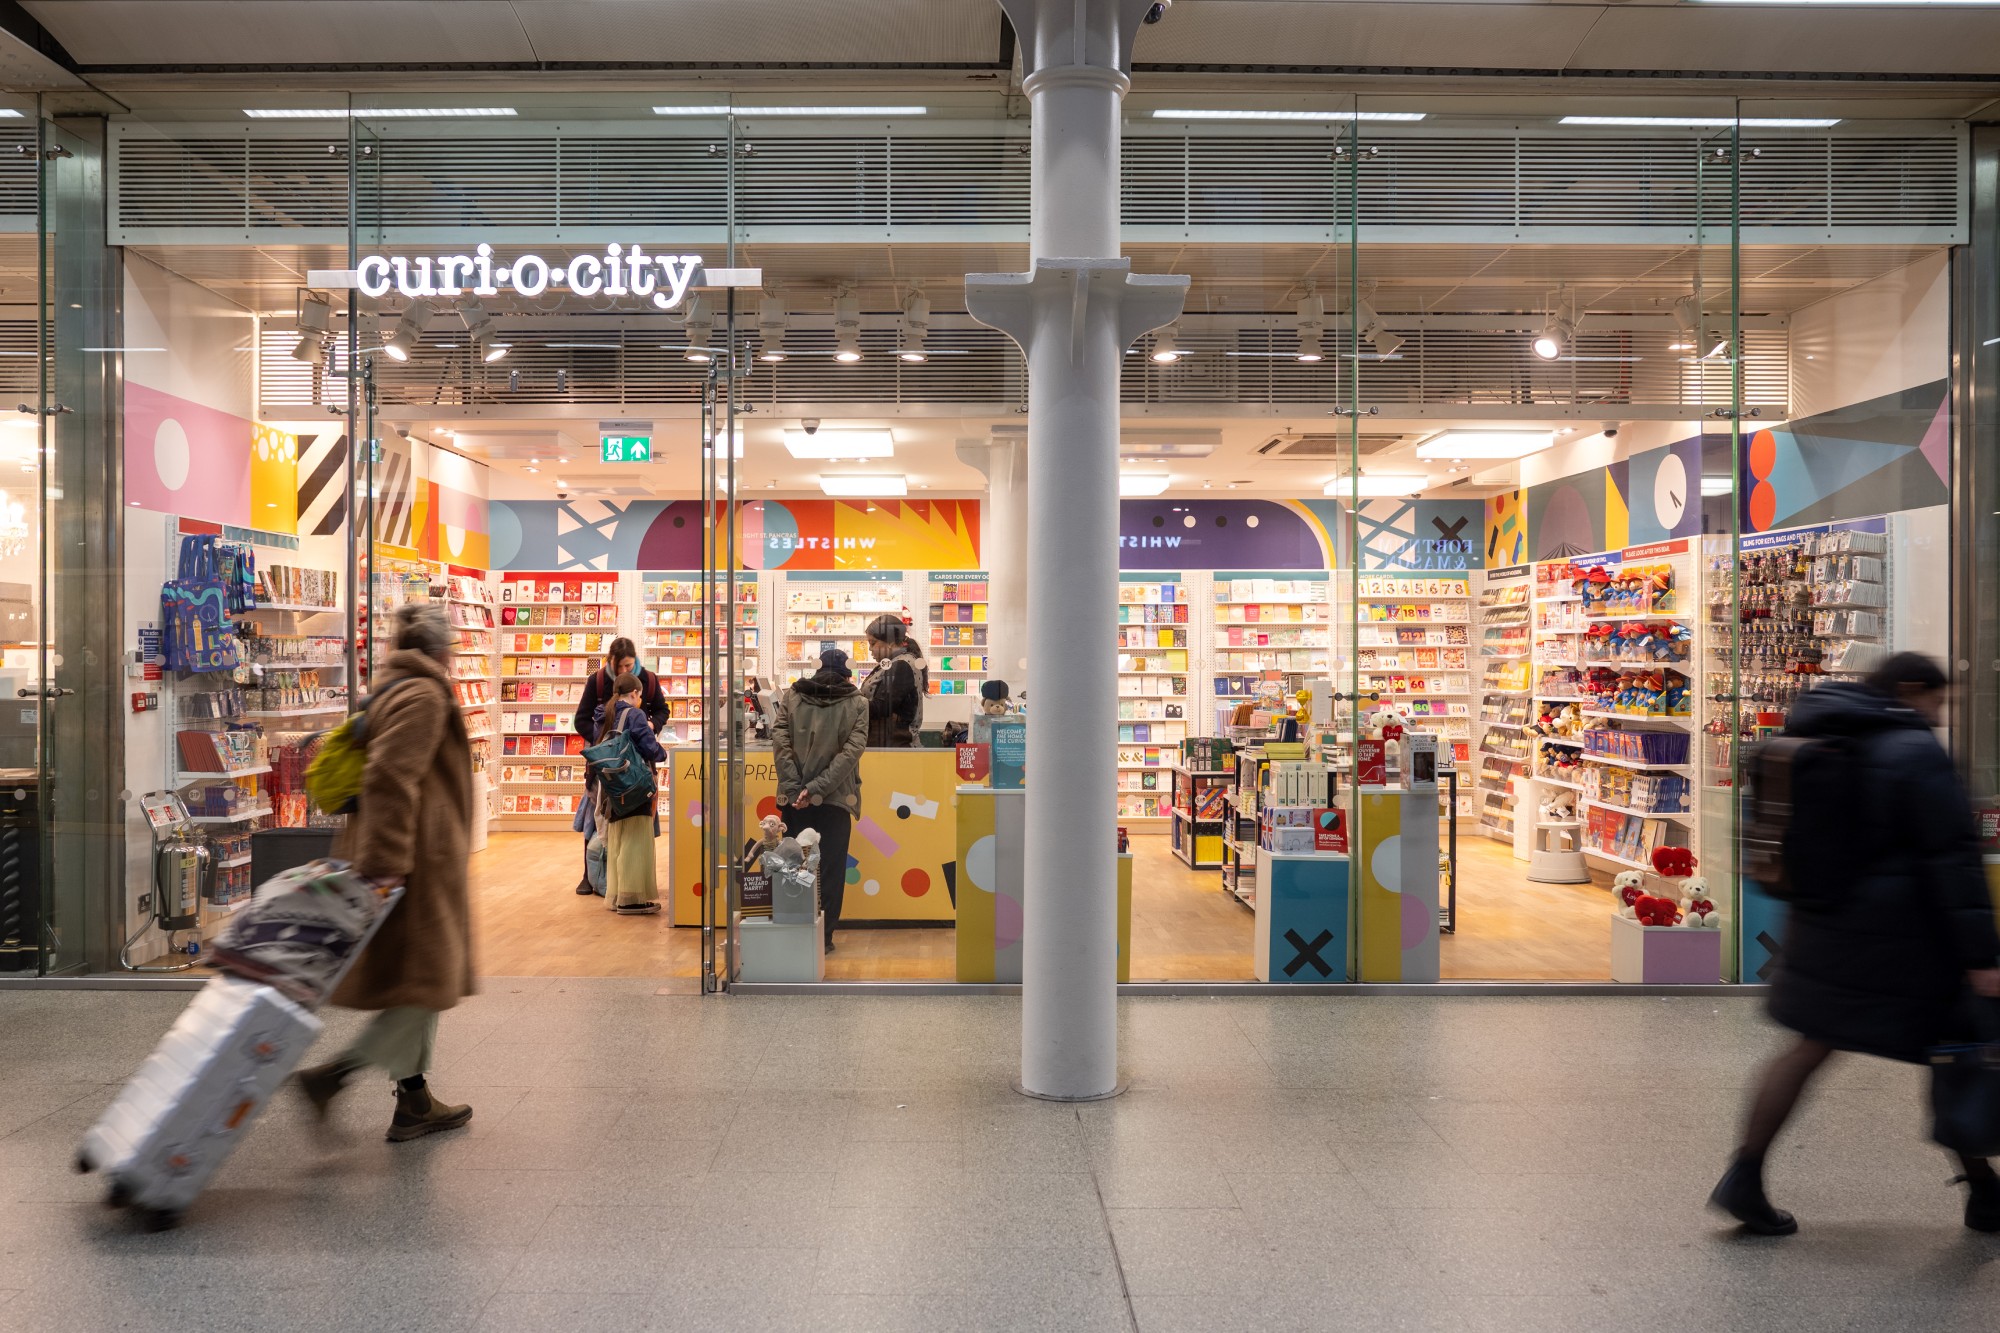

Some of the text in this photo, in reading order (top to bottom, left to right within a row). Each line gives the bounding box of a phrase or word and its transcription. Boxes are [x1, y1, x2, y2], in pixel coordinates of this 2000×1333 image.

[1743, 539, 1755, 547] BLING
[1755, 538, 1764, 546] FOR
[1776, 534, 1786, 543] BAGS
[1787, 533, 1797, 541] AND
[1371, 582, 1382, 594] 2
[1386, 583, 1395, 594] 3
[1400, 583, 1409, 595] 4
[1414, 583, 1424, 594] 5
[1429, 583, 1438, 595] 6
[1441, 583, 1451, 594] 7
[1454, 583, 1464, 595] 8
[1387, 607, 1400, 619] 17
[1403, 609, 1415, 617] 18
[1420, 652, 1435, 661] 40
[1372, 680, 1386, 689] 50
[1410, 680, 1424, 689] 60
[1413, 703, 1429, 712] 80
[1132, 751, 1143, 762] &
[1626, 891, 1637, 901] Lov
